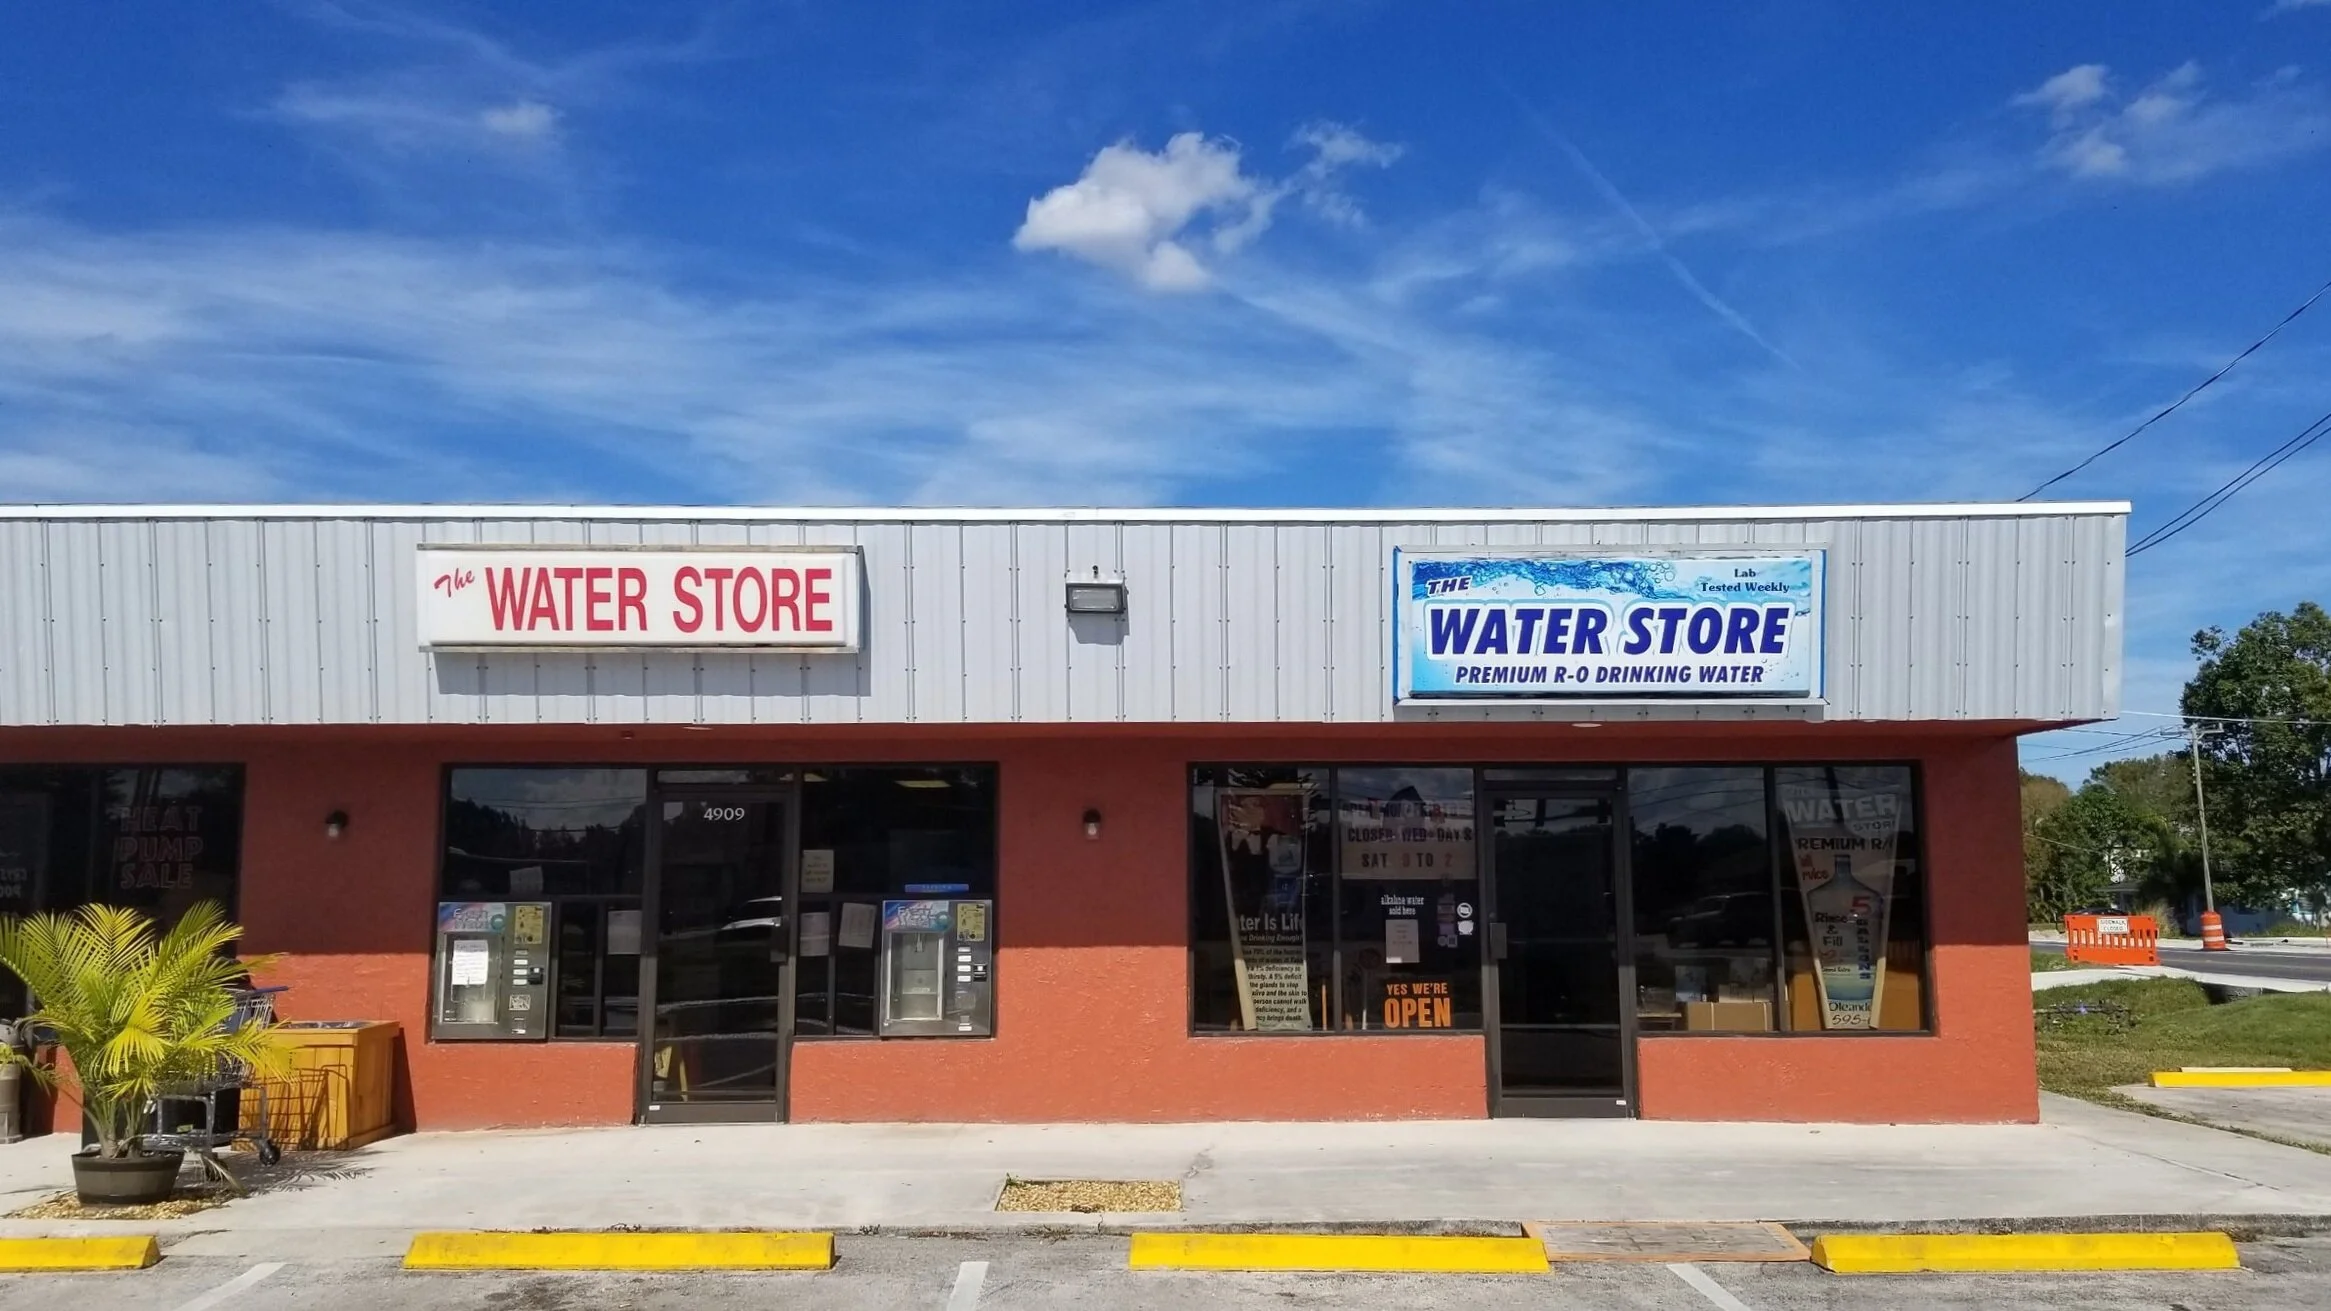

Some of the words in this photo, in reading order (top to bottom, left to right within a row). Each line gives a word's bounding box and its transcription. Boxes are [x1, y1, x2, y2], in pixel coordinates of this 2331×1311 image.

[1734, 568, 1757, 579] Lab
[1426, 576, 1471, 595] THE
[1701, 581, 1742, 593] Tested
[1744, 581, 1790, 595] Weekly
[434, 567, 475, 598] The
[485, 566, 648, 632] WATER
[672, 565, 833, 633] STORE
[1430, 607, 1610, 656] WATER
[1623, 606, 1789, 656] STORE
[1455, 665, 1547, 684] PREMIUM
[1553, 665, 1589, 684] R-O
[1594, 665, 1691, 684] DRINKING
[1698, 665, 1764, 684] WATER
[703, 807, 745, 821] 4909
[1782, 794, 1897, 822] WATER
[120, 805, 204, 832] HEAT
[1348, 828, 1393, 842] CLOSED
[119, 835, 204, 861] PUMP
[1795, 838, 1865, 850] REMIUM
[1361, 853, 1388, 868] SAT
[1416, 853, 1434, 867] TO
[120, 862, 194, 889] SALE
[1406, 896, 1425, 905] water
[1239, 914, 1261, 931] ter
[1264, 913, 1277, 931] Is
[1826, 925, 1838, 934] &
[1823, 935, 1842, 947] Fill
[1386, 984, 1408, 995] YES
[1412, 982, 1448, 995] WE'RE
[1384, 997, 1451, 1029] OPEN
